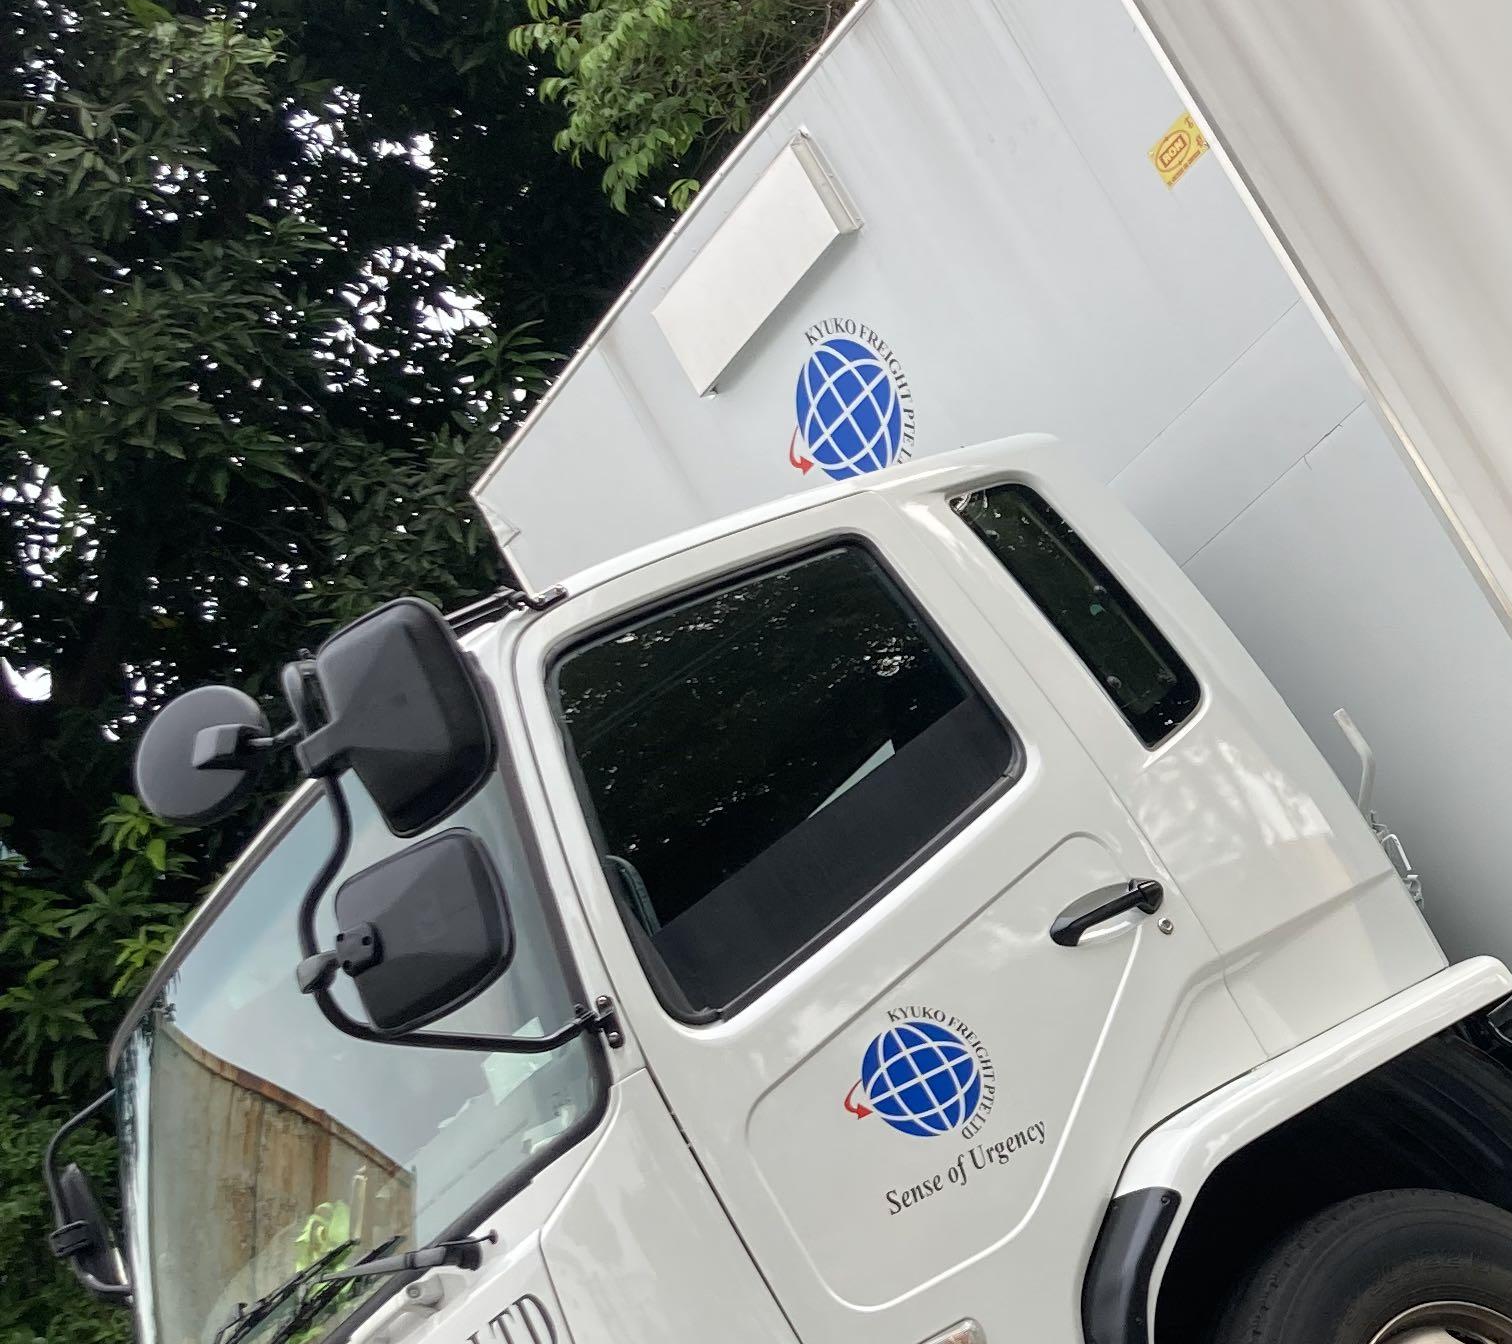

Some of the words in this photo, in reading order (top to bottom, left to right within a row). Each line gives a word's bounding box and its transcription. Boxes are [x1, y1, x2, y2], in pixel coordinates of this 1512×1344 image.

[804, 317, 857, 346] KYUKO
[859, 323, 913, 404] FREIGHT
[902, 407, 916, 447] PTE
[887, 1006, 946, 1023] KYUKO
[948, 1016, 996, 1082] FREIGHT
[982, 1084, 997, 1119] PTE
[961, 1116, 989, 1141] LTD
[885, 1173, 944, 1216] Sense
[948, 1154, 968, 1186] of
[967, 1120, 1047, 1170] Urgency
